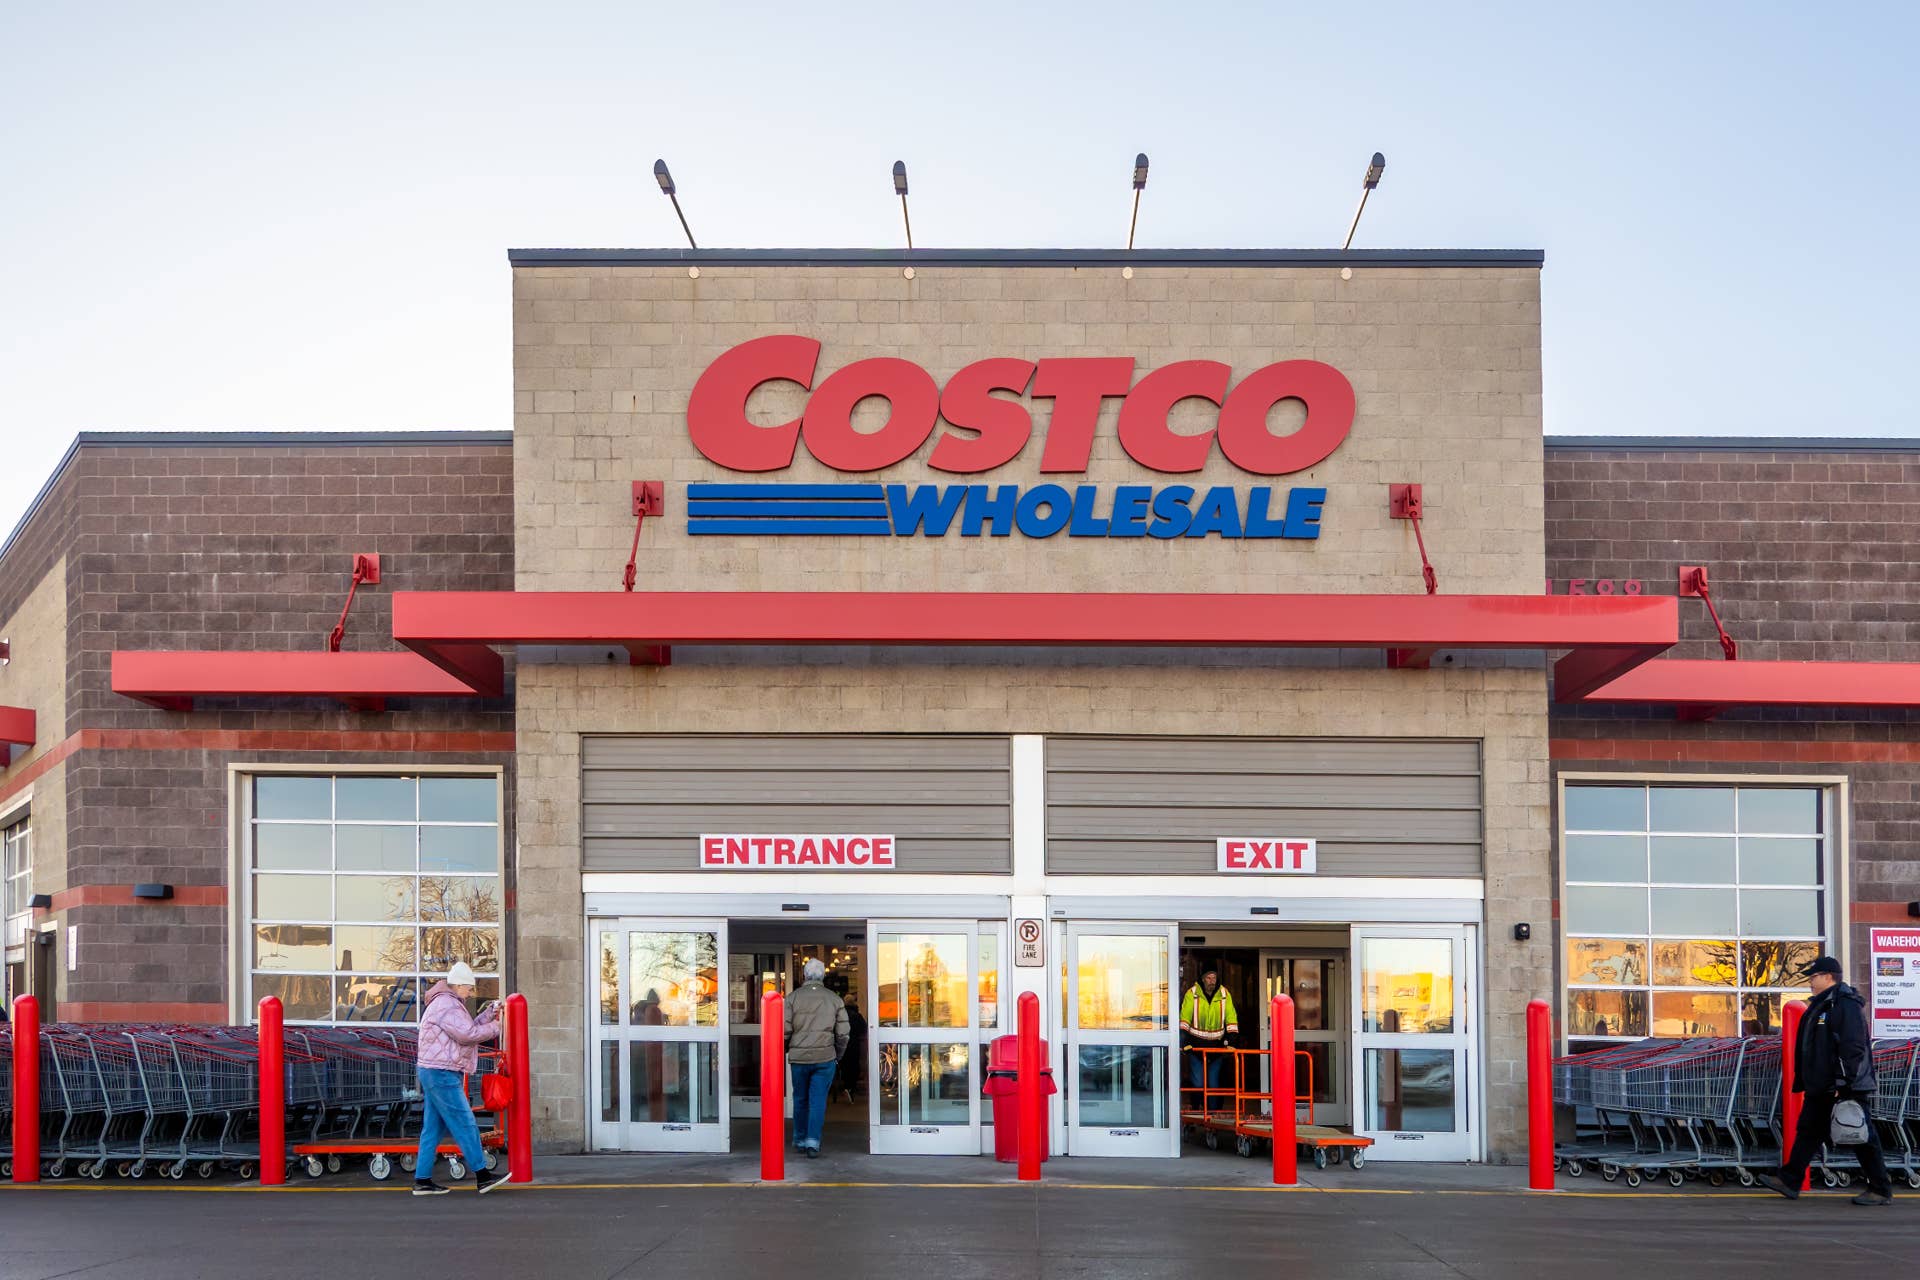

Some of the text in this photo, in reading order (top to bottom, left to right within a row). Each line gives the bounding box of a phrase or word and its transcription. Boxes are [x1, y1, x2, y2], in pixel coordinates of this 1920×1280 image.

[687, 335, 1356, 474] COSTCO
[886, 483, 1327, 540] WHOLESALE
[704, 838, 892, 865] ENTRANCE
[1226, 842, 1309, 869] EXIT
